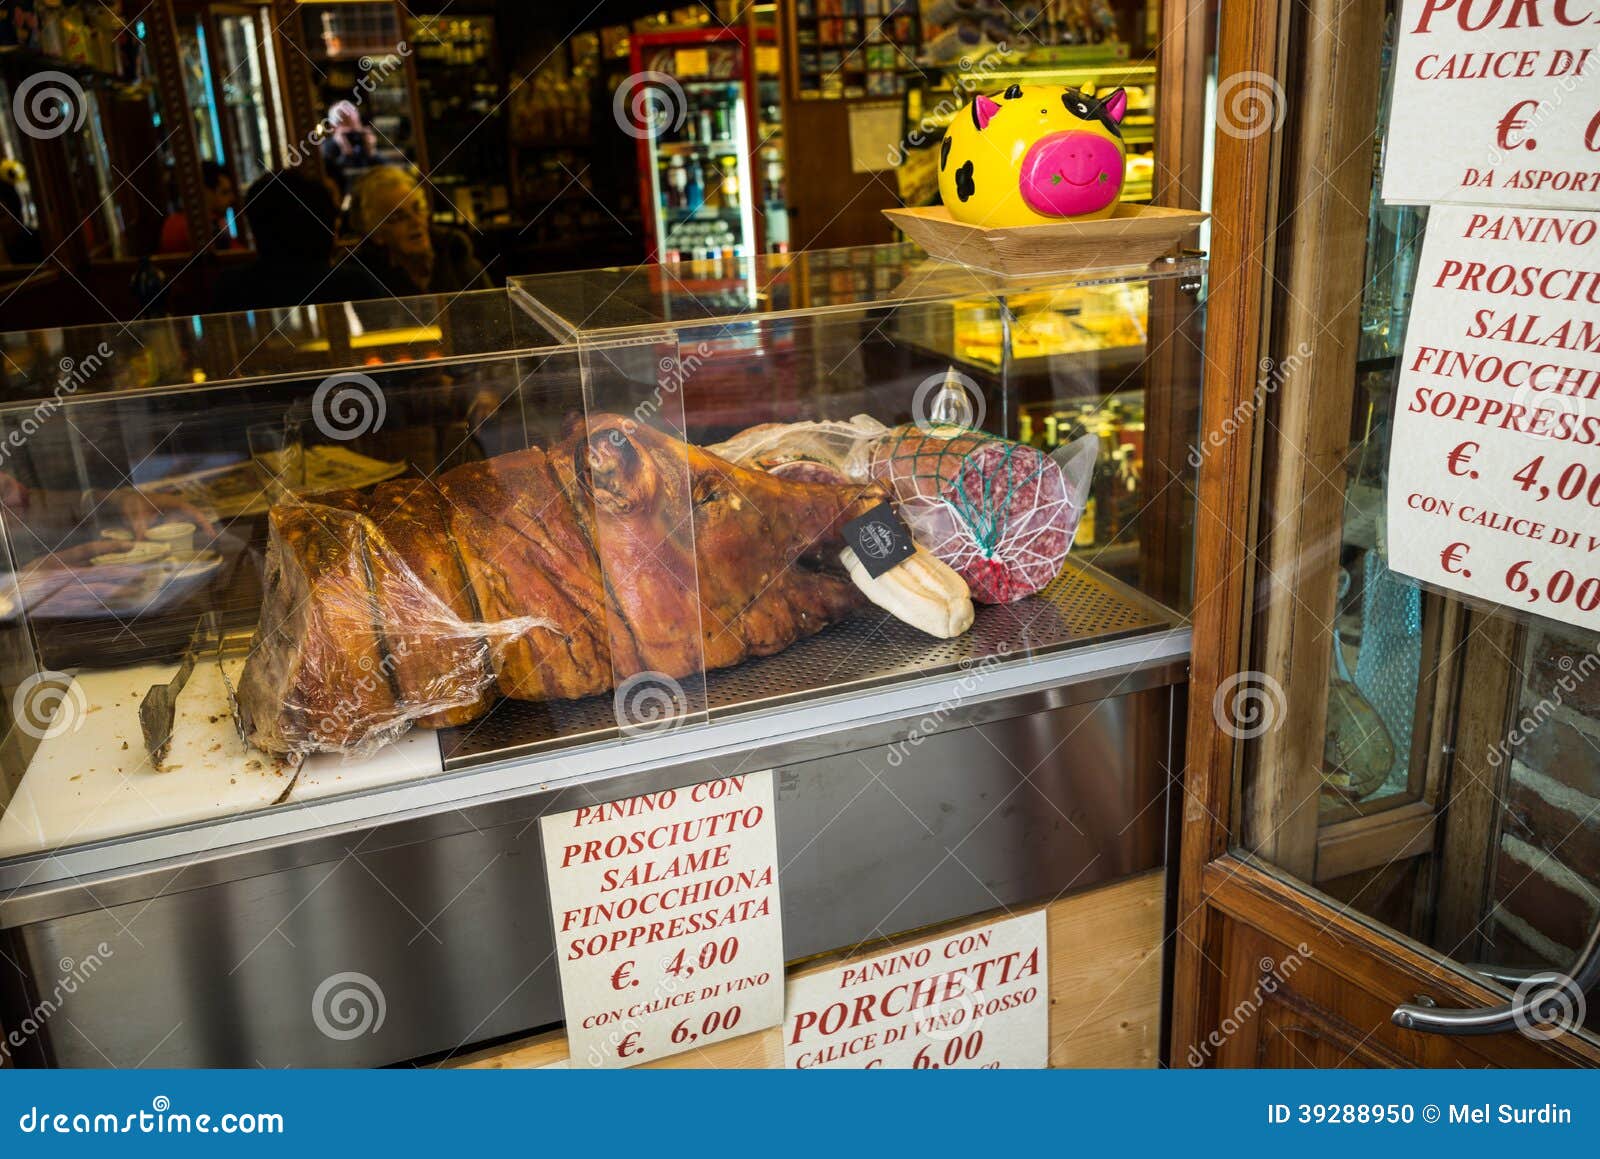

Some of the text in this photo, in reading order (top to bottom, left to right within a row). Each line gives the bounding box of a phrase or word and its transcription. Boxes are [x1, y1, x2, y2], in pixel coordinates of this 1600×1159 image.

[1410, 0, 1600, 34] PORC
[1415, 48, 1593, 80] CALICE DI
[1496, 99, 1539, 151] €.
[1461, 168, 1600, 192] DA ASPORT
[1463, 214, 1597, 246] PANINO
[1466, 309, 1600, 353] SALAM
[1410, 346, 1600, 400] FINOCCHI
[1408, 387, 1600, 447] SOPPRESS
[1447, 441, 1480, 481] €.
[1407, 493, 1454, 517] CON
[1458, 506, 1546, 540] CALICE
[1548, 528, 1581, 549] DI
[1440, 542, 1600, 612] €. 6,00
[573, 775, 747, 827] PANINO CON
[559, 806, 763, 868] PROSCIUTTO
[600, 844, 731, 892] SALAME
[559, 866, 773, 932] FINOCCHIONA
[567, 896, 769, 961] SOPPRESSATA
[610, 936, 739, 990] €. 4,00
[839, 930, 992, 988] PANINO CON
[582, 972, 770, 1029] CON CALICE DI VINO
[788, 946, 1040, 1046] PORCHETTA
[617, 1005, 741, 1058] €. 6,00
[796, 987, 1037, 1069] CALICE DI VINO ROSSO
